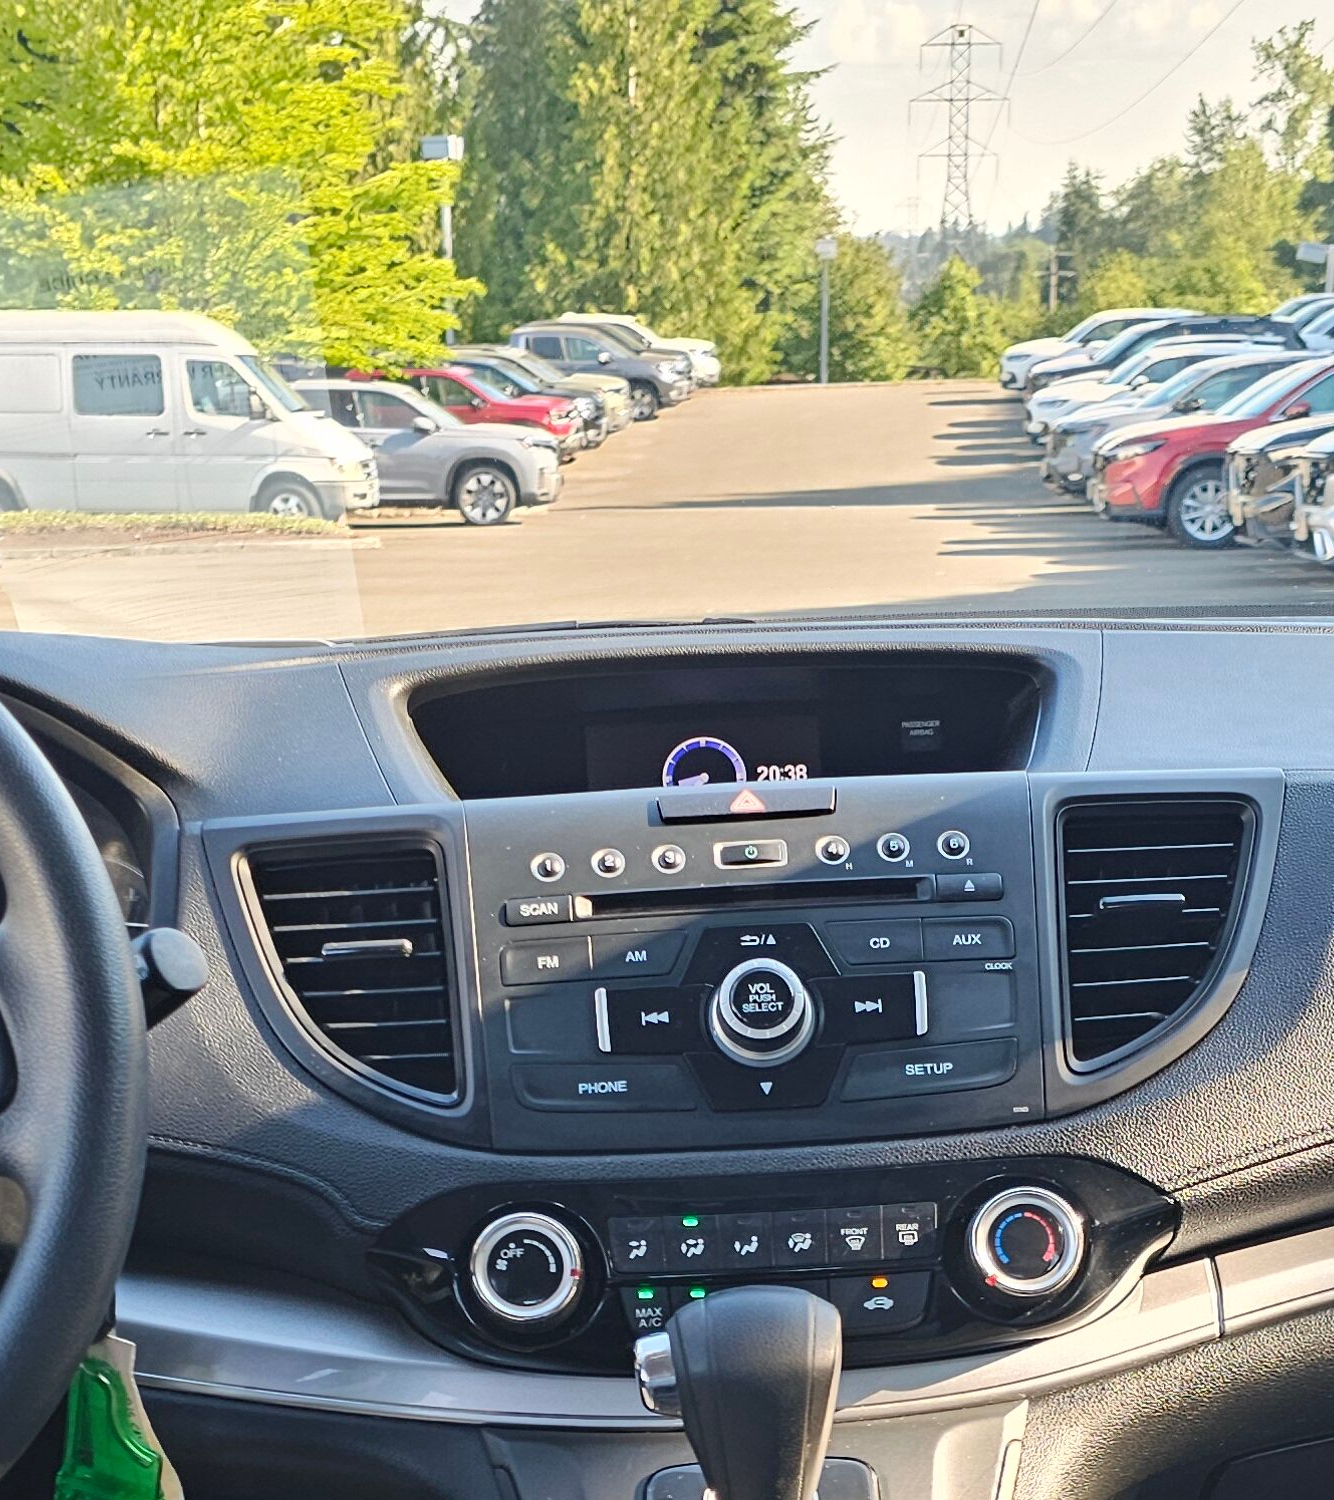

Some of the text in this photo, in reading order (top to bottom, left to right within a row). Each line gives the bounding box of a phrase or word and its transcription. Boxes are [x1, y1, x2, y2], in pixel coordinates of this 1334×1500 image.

[756, 764, 808, 781] 20:38
[829, 842, 840, 854] 4
[889, 840, 899, 851] 5
[949, 838, 959, 849] 6
[605, 854, 616, 867] 2
[664, 850, 675, 863] 3
[544, 859, 552, 872] 1
[519, 902, 559, 917] SCAN
[869, 937, 890, 949] CD
[952, 934, 982, 946] AUX
[537, 955, 559, 969] FM
[625, 950, 647, 963] AM
[985, 962, 1013, 971] CLOCK
[748, 983, 775, 994] VOL
[749, 993, 776, 1003] PUSH
[742, 1001, 784, 1013] SELECT
[905, 1062, 954, 1076] SETUP
[578, 1080, 628, 1095] PHONE
[840, 1227, 868, 1236] FRONT
[896, 1223, 919, 1231] REAR
[500, 1248, 525, 1259] OFF
[635, 1307, 663, 1318] MAX
[638, 1317, 662, 1328] A/C
